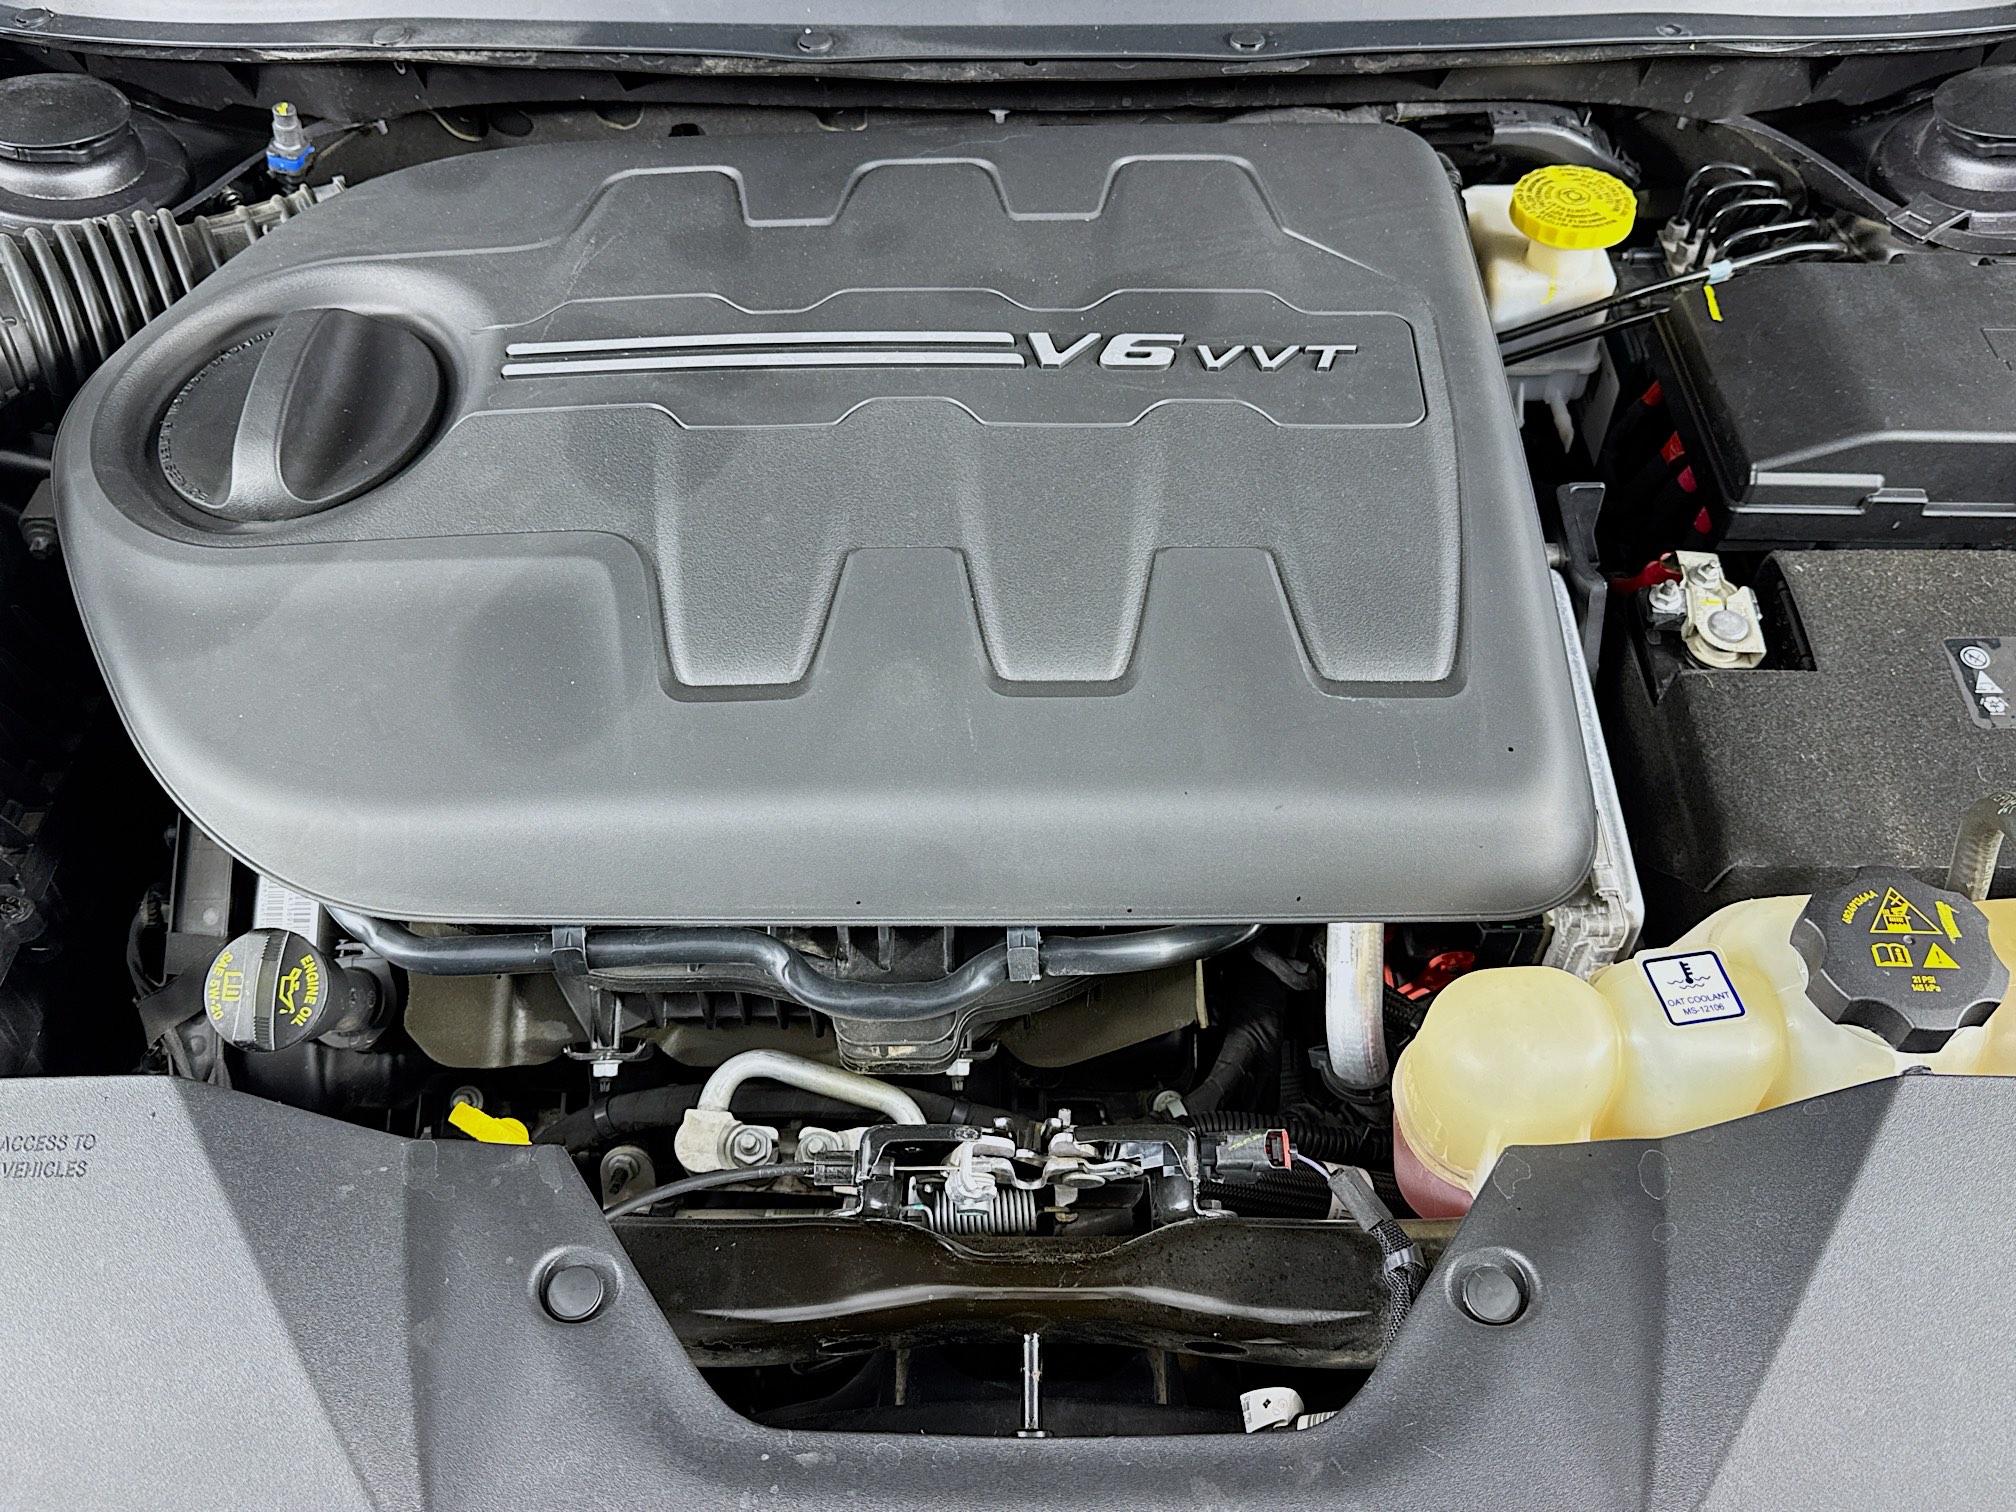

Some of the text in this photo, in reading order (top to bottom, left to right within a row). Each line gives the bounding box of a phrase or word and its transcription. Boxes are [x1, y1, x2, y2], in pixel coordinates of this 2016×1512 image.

[1028, 332, 1358, 372] V6 VVT
[208, 951, 233, 1021] SAE 5W-20
[1911, 975, 1936, 984] 21 PSI
[1924, 983, 1942, 993] kPa
[290, 954, 320, 1027] ENGINE OIL
[1667, 991, 1730, 1007] OAT COOLANT
[1683, 1003, 1725, 1015] MS-12106
[0, 1133, 96, 1152] ACCESS TO
[2, 1160, 88, 1178] VEHICLES
